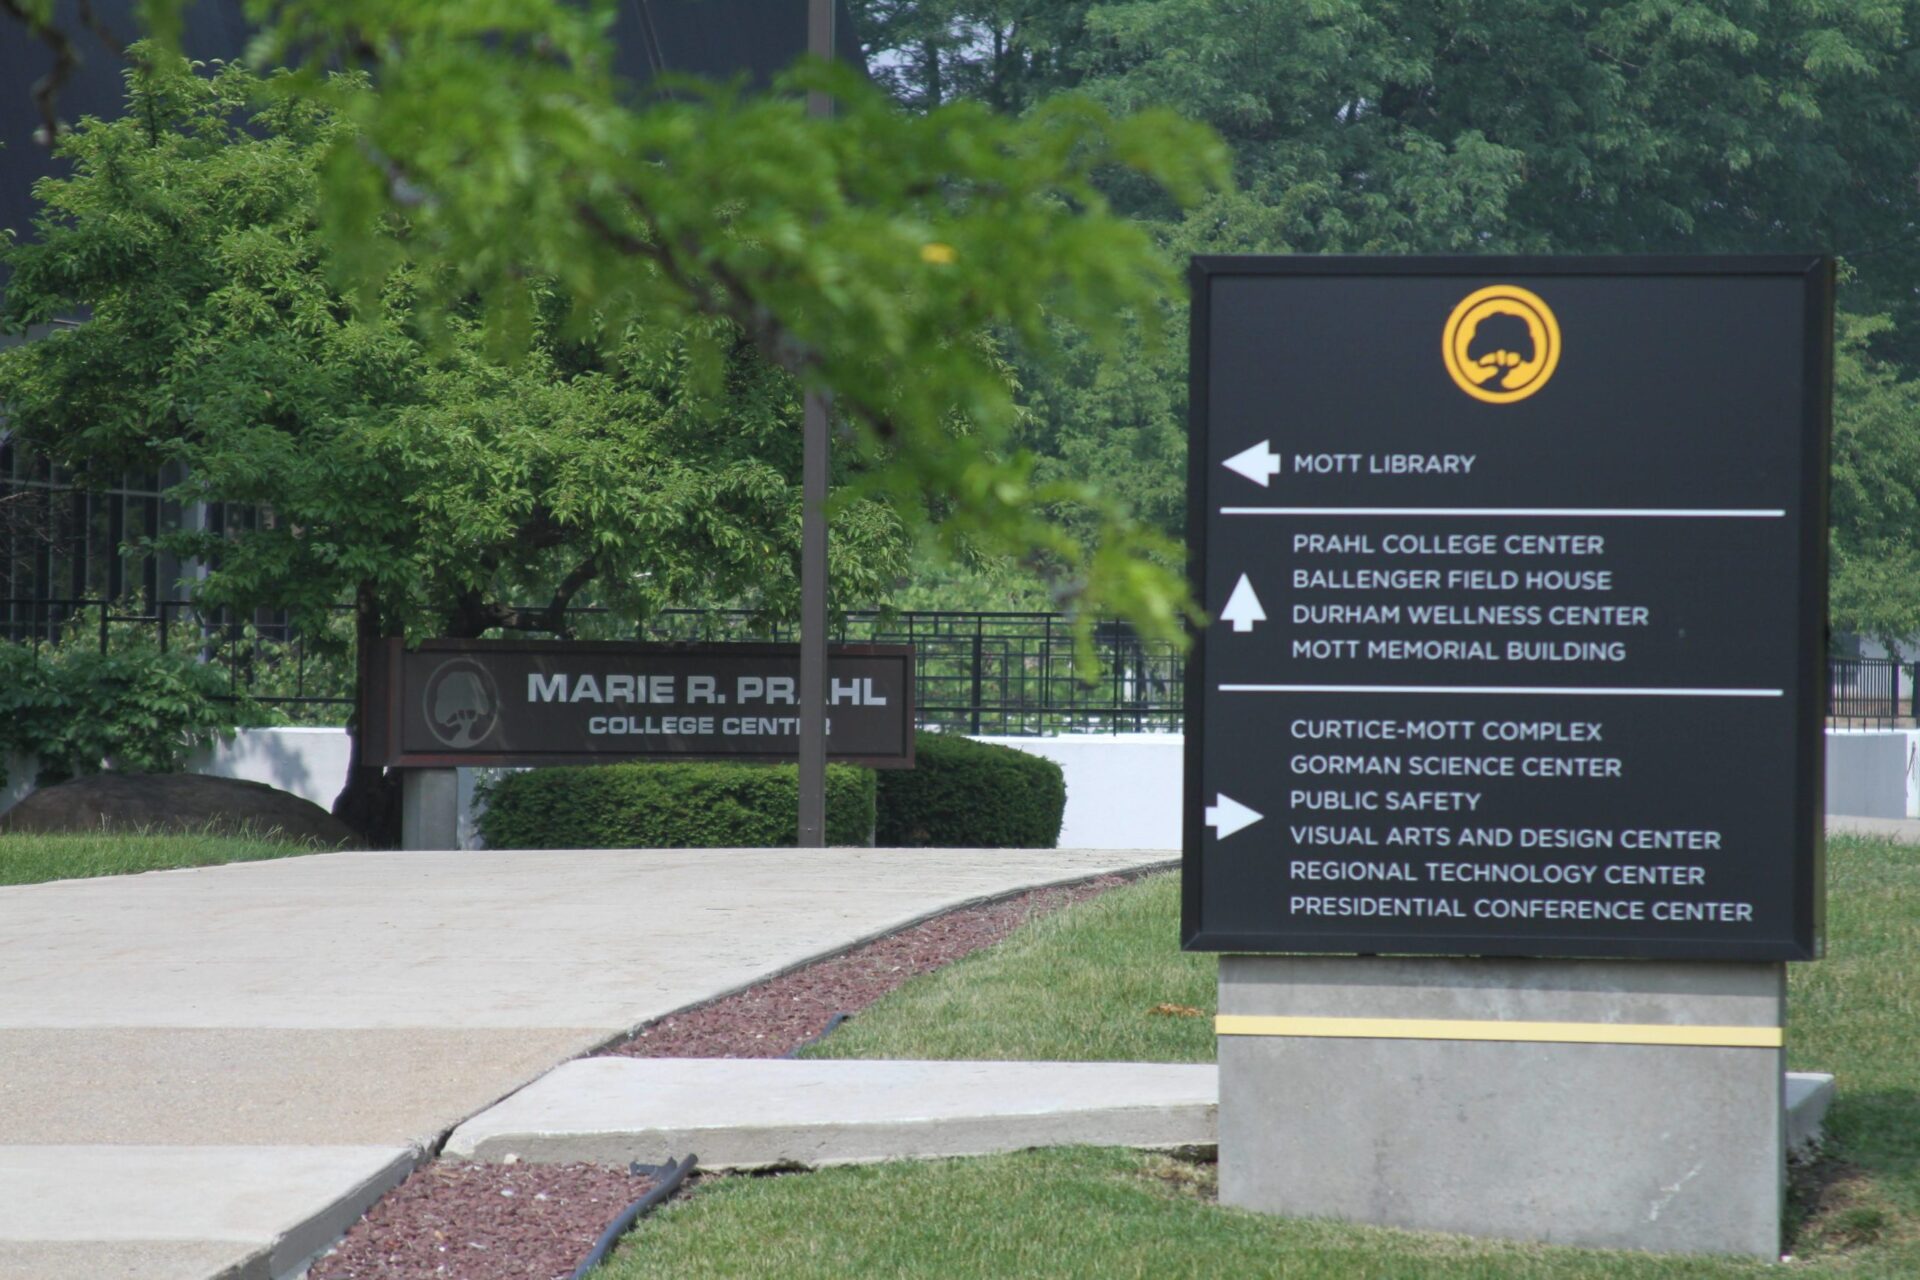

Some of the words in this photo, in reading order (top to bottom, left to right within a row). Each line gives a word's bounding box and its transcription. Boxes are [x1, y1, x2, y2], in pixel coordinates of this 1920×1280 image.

[1294, 453, 1363, 474] MOTT
[1369, 454, 1476, 474] LIBRARY
[1293, 533, 1375, 554] PRAHL
[1382, 534, 1497, 555] COLLEGE
[1503, 534, 1605, 555] CENTER
[1293, 569, 1441, 590] BALLENGER
[1448, 569, 1519, 590] FIELD
[1525, 570, 1612, 591] HOUSE
[1292, 604, 1400, 624] DURHAM
[1407, 605, 1542, 626] WELLNESS
[1548, 605, 1649, 626] CENTER
[1292, 639, 1361, 659] MOTT
[1367, 640, 1500, 661] MEMORIAL
[1507, 641, 1626, 662] BUILDING
[528, 673, 674, 703] MARIE
[687, 676, 725, 704] R.
[737, 677, 887, 706] PRHL
[589, 717, 714, 734] COLLEGE
[722, 717, 831, 735] CENT
[1290, 719, 1476, 740] CURTICE-MOTT
[1482, 721, 1602, 742] COMPLEX
[1290, 754, 1401, 775] GORMAN
[1408, 755, 1515, 777] SCIENCE
[1521, 757, 1622, 777] CENTER
[1290, 789, 1378, 811] PUBLIC
[1385, 791, 1481, 811] SAFETY
[1290, 825, 1379, 846] VISUAL
[1385, 826, 1451, 847] ARTS
[1457, 827, 1513, 847] AND
[1520, 828, 1613, 849] DESIGN
[1620, 829, 1721, 850] CENTER
[1290, 860, 1418, 882] REGIONAL
[1425, 862, 1598, 884] TECHNOLOGY
[1604, 865, 1705, 885] CENTER
[1290, 896, 1467, 918] PRESIDENTIAL
[1473, 898, 1645, 920] CONFERENCE
[1651, 901, 1753, 922] CENTER
